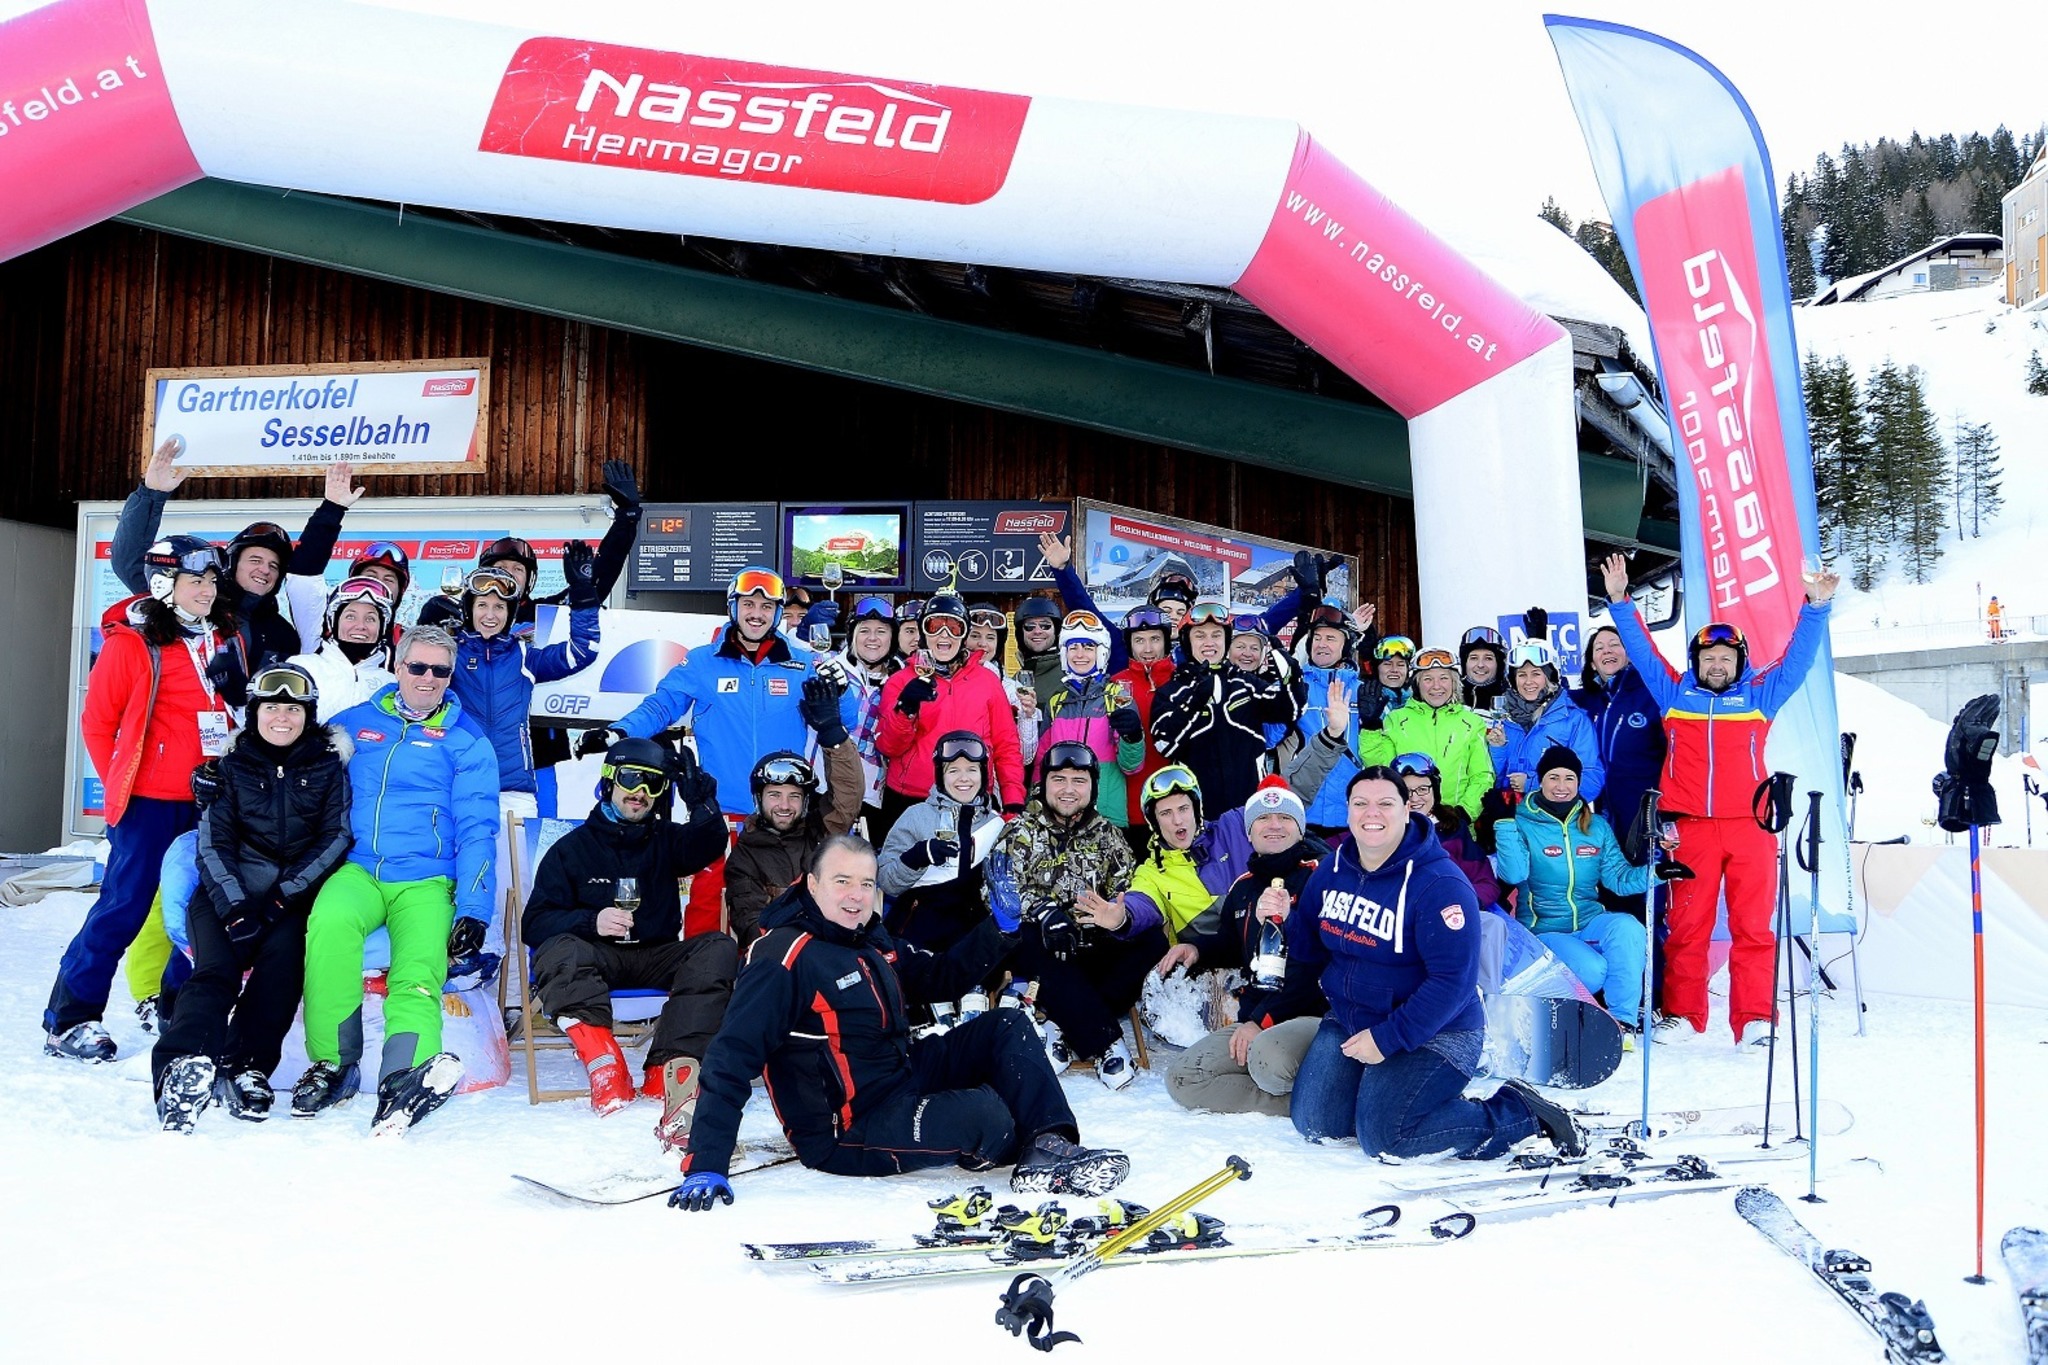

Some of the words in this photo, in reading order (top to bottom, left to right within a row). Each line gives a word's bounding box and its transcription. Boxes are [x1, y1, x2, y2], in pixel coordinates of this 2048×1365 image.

[574, 68, 952, 155] Nassfeld
[561, 122, 803, 177] Hermagor
[1284, 189, 1499, 361] www.nassfeld.at
[177, 378, 360, 414] Gartnerkofel
[430, 381, 468, 391] Nassfeld
[259, 414, 431, 449] Sesselbahn
[320, 453, 332, 461] bis
[1005, 516, 1055, 528] Nassfeld
[429, 546, 470, 554] Nassfeld
[544, 693, 591, 715] OFF
[1344, 930, 1378, 947] Austria
